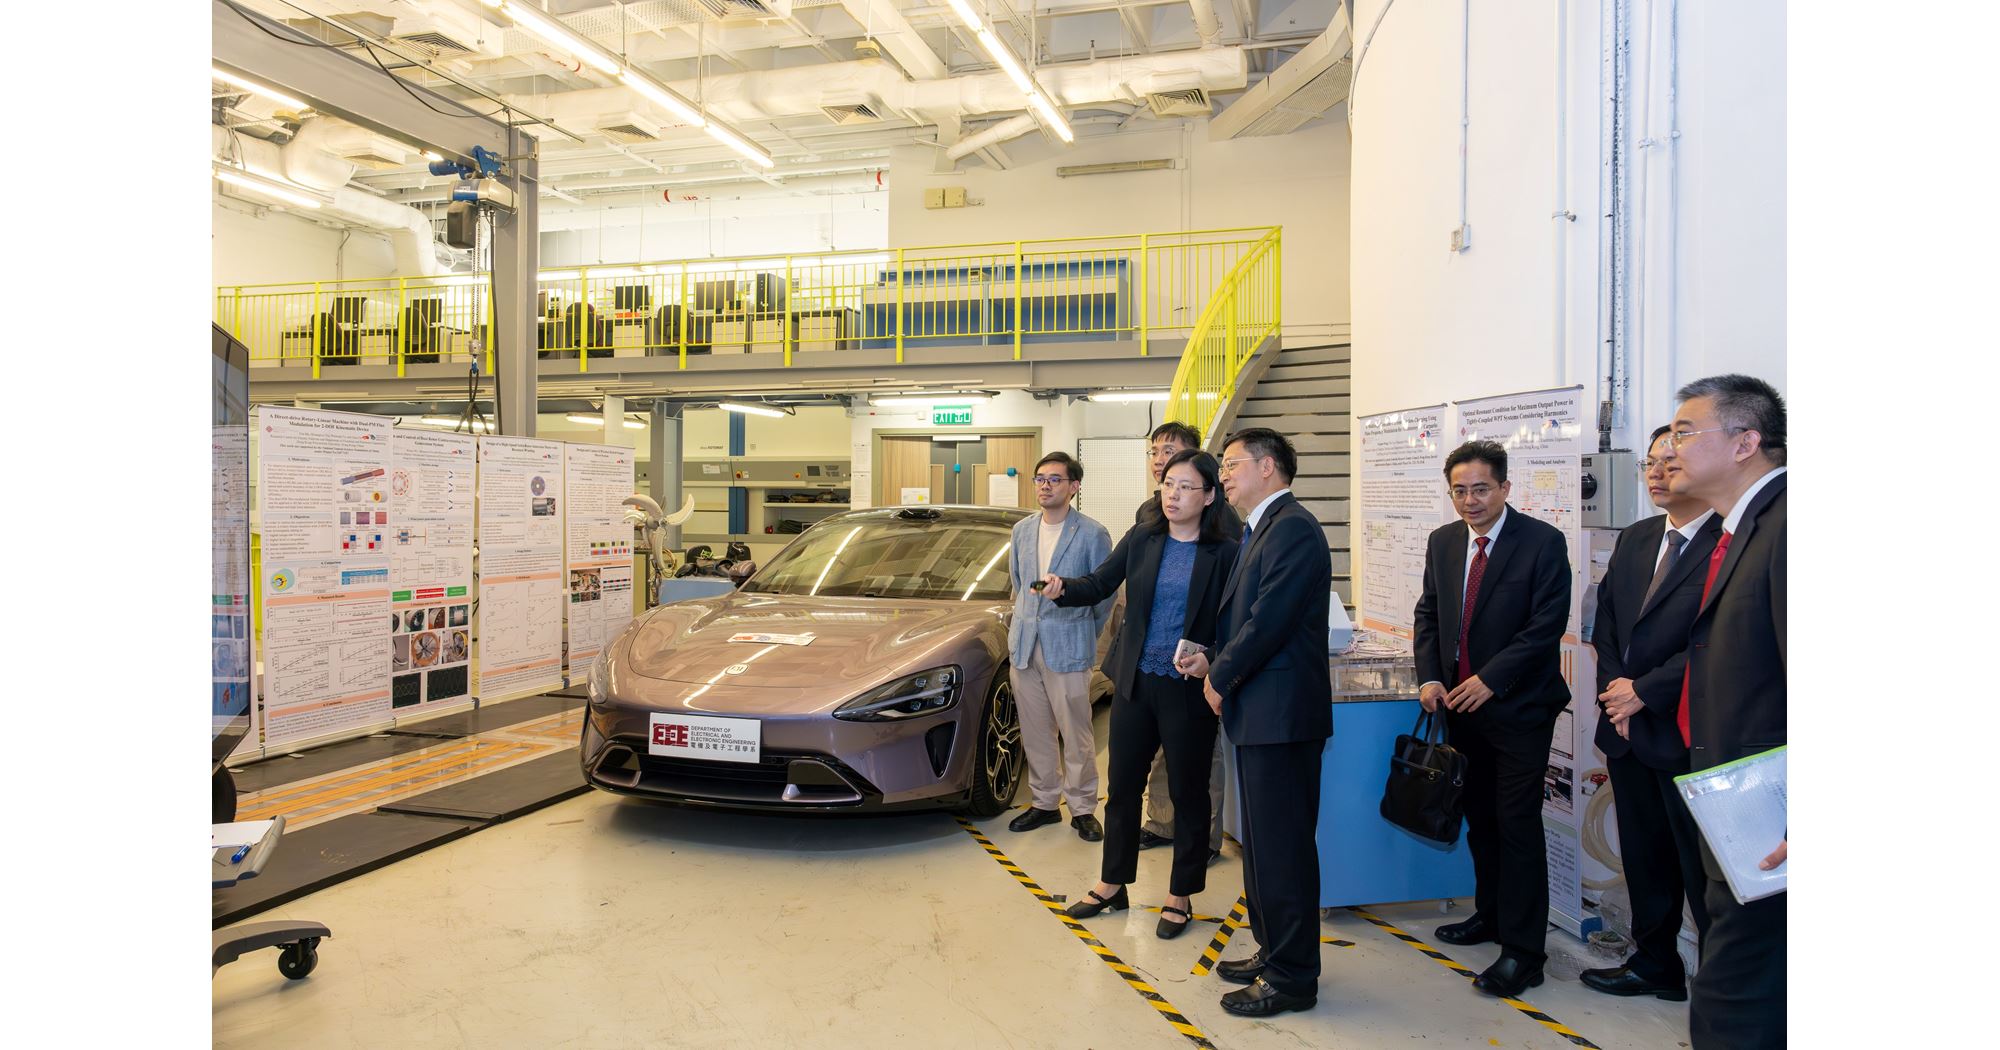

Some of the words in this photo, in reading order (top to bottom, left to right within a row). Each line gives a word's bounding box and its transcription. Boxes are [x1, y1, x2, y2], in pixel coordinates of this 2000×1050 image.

[1517, 403, 1537, 411] Maximum
[934, 411, 953, 423] EXIT
[1503, 414, 1519, 422] Systems
[1544, 409, 1568, 417] Harmonics
[652, 723, 688, 747] EEE
